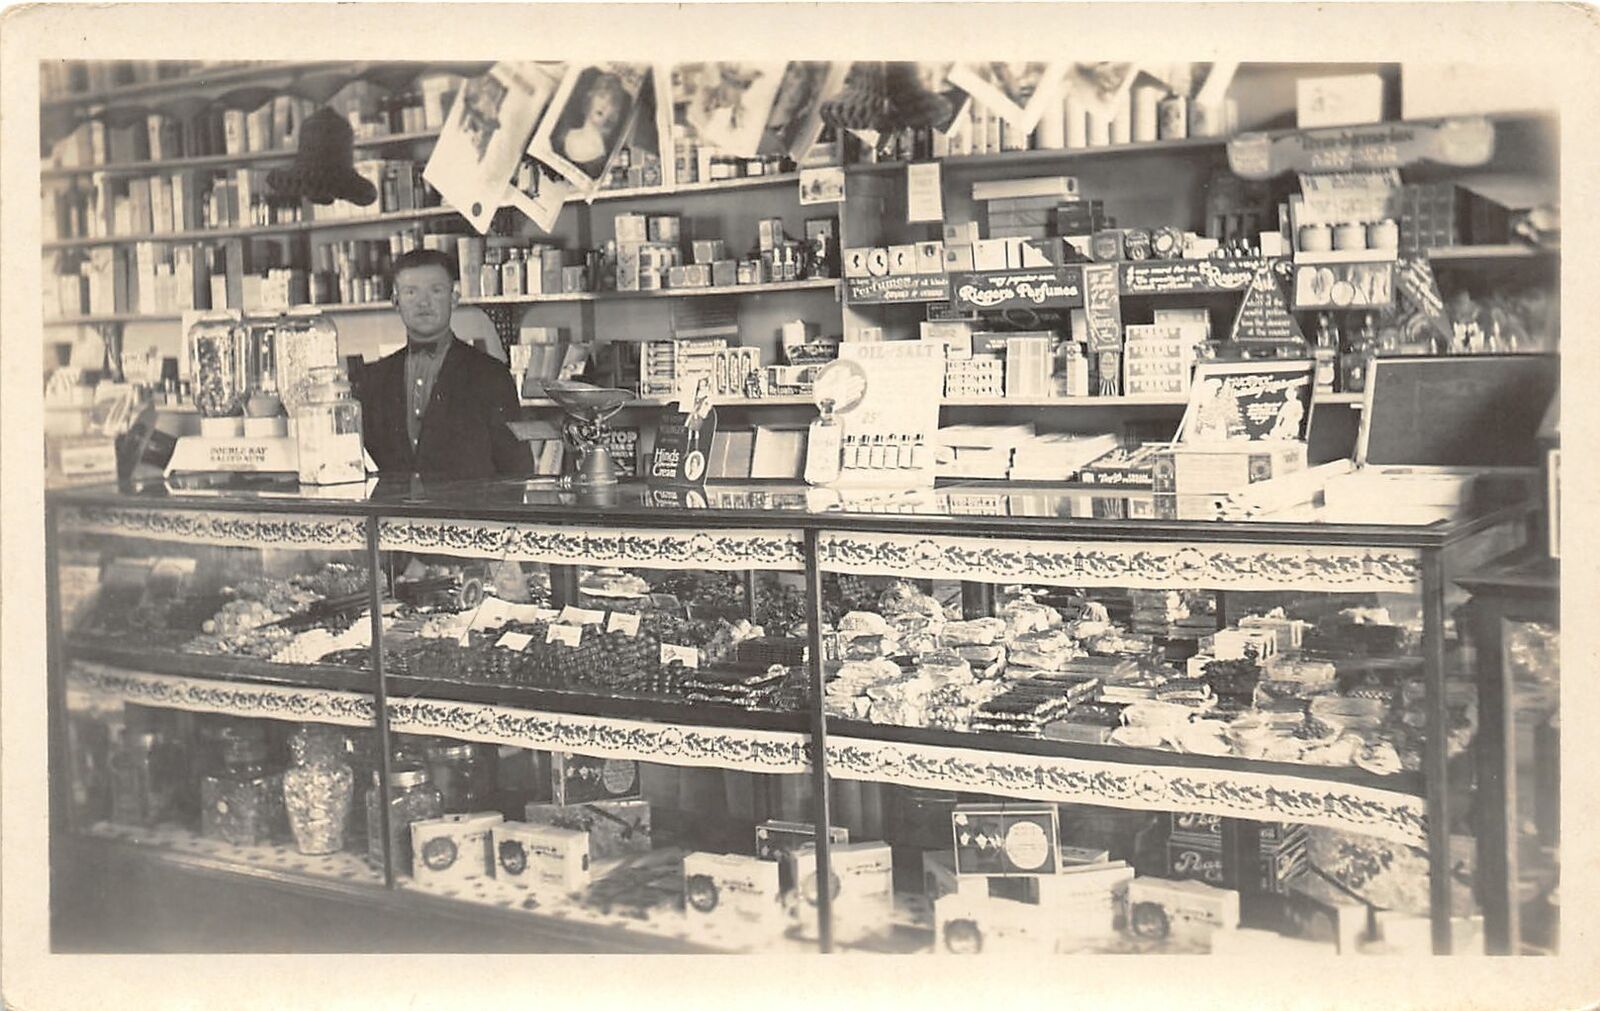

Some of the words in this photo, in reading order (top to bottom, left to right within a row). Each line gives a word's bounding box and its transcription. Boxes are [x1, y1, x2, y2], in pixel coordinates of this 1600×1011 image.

[1016, 282, 1078, 304] Perfumes
[654, 448, 680, 463] Hinds
[653, 463, 676, 478] Cream
